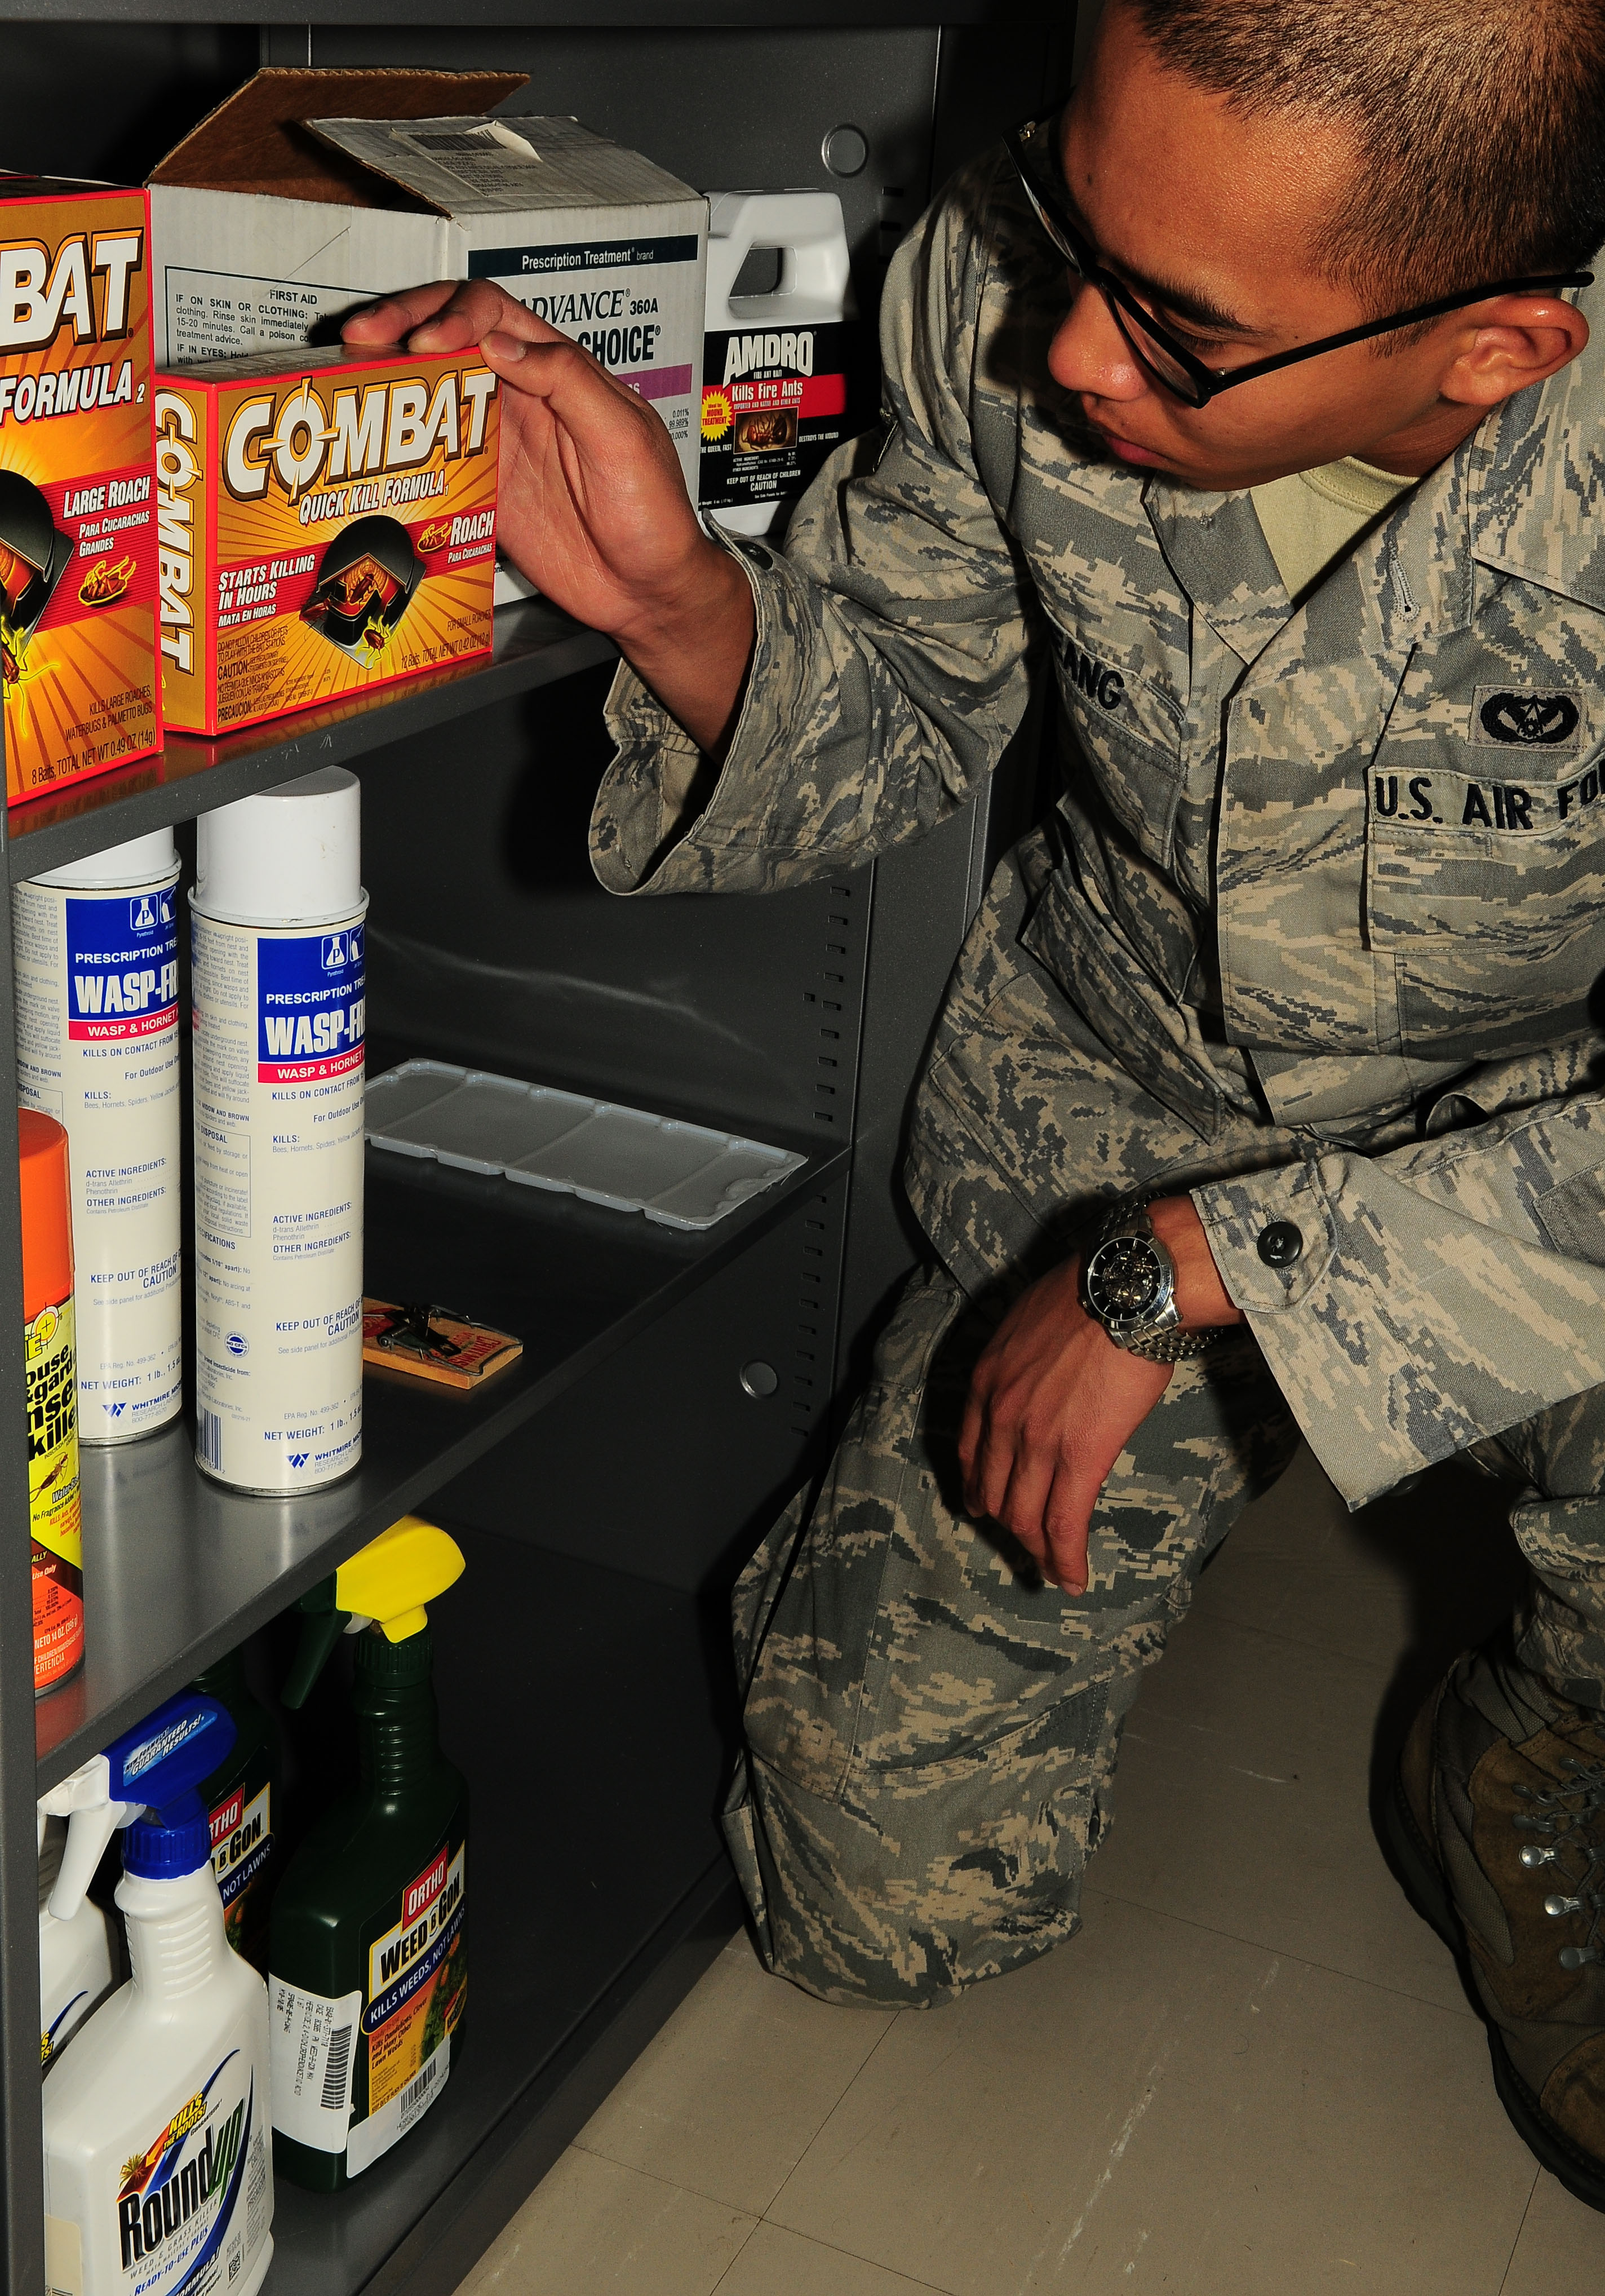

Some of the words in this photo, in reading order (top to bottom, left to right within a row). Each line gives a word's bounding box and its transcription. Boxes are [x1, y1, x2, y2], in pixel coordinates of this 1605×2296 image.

[522, 252, 581, 271] Prescription
[584, 247, 631, 265] Treatment
[637, 249, 654, 261] brand
[176, 294, 184, 303] IF
[190, 296, 203, 306] ON
[210, 298, 231, 309] SKIN
[238, 302, 251, 312] OR
[258, 305, 308, 320] CLOTHING:
[269, 289, 298, 302] FIRST
[300, 294, 317, 305] AID
[629, 298, 659, 316] 360A
[176, 306, 208, 319] clothing.
[213, 311, 236, 321] Rinse
[240, 315, 256, 324] skin
[261, 317, 309, 333] immediately
[176, 317, 198, 328] 15-20
[202, 322, 235, 333] minutes.
[240, 326, 255, 335] Call
[269, 329, 295, 341] poison
[176, 329, 213, 341] treatment
[215, 334, 243, 345] advice.
[177, 343, 184, 352] IF
[201, 347, 227, 358] EYES:
[722, 331, 814, 389] AMDRO
[0, 361, 133, 425] FORMULA
[731, 385, 754, 402] Kills
[758, 382, 777, 399] Fire
[782, 379, 803, 397] Ants
[227, 369, 497, 502] COMBAT
[750, 480, 777, 492] CAUTION
[757, 474, 772, 483] REACH
[773, 472, 779, 481] OF
[779, 470, 801, 479] CHILDREN
[64, 485, 105, 519] LARGE
[110, 475, 151, 506] ROACH
[299, 490, 346, 525] QUICK
[349, 483, 380, 514] KILL
[384, 470, 444, 506] FORMULA
[79, 521, 100, 540] PARA
[102, 510, 150, 533] CUCARACHAS
[156, 393, 202, 676] COMBAT
[449, 510, 495, 547] ROACH
[79, 537, 114, 558] GRANDES
[447, 551, 462, 564] PARA
[462, 542, 493, 560] CUCARACHAS
[218, 567, 266, 594] STARTS
[269, 554, 316, 583] KILLING
[218, 589, 234, 611] IN
[236, 582, 277, 608] HOURS
[218, 612, 241, 627] MATA
[241, 611, 252, 622] EN
[252, 604, 277, 620] HORAS
[218, 660, 250, 681] CAUTION:
[1053, 629, 1125, 710] ANG
[90, 701, 105, 716] KILLS
[105, 694, 125, 711] LARGE
[125, 684, 152, 705] ROACHES,
[218, 697, 253, 722] PRECAUCIÓN:
[65, 718, 101, 742] WATERBUGS
[102, 716, 107, 729] &
[108, 705, 136, 727] PALMETTO
[138, 701, 153, 716] BUGS
[32, 768, 37, 785] 8
[38, 763, 57, 784] Baits,
[57, 753, 81, 775] TOTAL
[82, 747, 96, 767] NET
[97, 742, 109, 761] WT
[110, 737, 126, 757] 0.49
[127, 733, 137, 751] OZ
[138, 727, 156, 751] (14g)
[1375, 776, 1443, 824] U.S.
[1463, 783, 1534, 830] AIR
[75, 943, 163, 964] PRESCRIPTION
[74, 958, 179, 1014] WASP-FR
[266, 984, 353, 1006] PRESCRIPTION
[87, 1021, 127, 1037] WASP
[130, 1023, 138, 1033] &
[141, 1010, 176, 1032] HORNET
[83, 1048, 107, 1058] KILLS
[110, 1047, 122, 1057] ON
[125, 1042, 158, 1055] CONTACT
[159, 1035, 174, 1046] FROM
[277, 1065, 316, 1080] WASP
[319, 1065, 327, 1076] &
[330, 1053, 362, 1074] HORNET
[272, 1091, 296, 1101] KILLS
[299, 1090, 312, 1099] ON
[314, 1083, 345, 1098] CONTACT
[347, 1077, 360, 1090] FROM
[313, 1114, 326, 1123] For
[327, 1107, 352, 1121] Outdoor
[273, 1135, 300, 1144] KILLS:
[273, 1213, 303, 1224] ACTIVE
[305, 1202, 352, 1222] INGREDIENTS:
[273, 1242, 300, 1253] OTHER
[304, 1231, 351, 1251] INGREDIENTS:
[90, 1273, 114, 1284] KEEP
[116, 1272, 135, 1284] OUT
[138, 1269, 149, 1280] OF
[150, 1259, 171, 1276] REACH
[143, 1265, 177, 1289] CAUTION
[276, 1321, 300, 1331] KEEP
[303, 1318, 320, 1330] OUT
[323, 1315, 334, 1326] OF
[335, 1304, 354, 1322] REACH
[328, 1311, 359, 1336] CAUTION
[81, 1381, 99, 1391] NET
[101, 1375, 141, 1390] WEIGHT:
[132, 1391, 170, 1410] WHITMIRE
[264, 1431, 282, 1441] NET
[286, 1426, 325, 1440] WEIGHT:
[314, 1440, 352, 1461] WHITMIRE
[132, 1720, 187, 1776] GUARANTEED
[162, 1713, 202, 1757] RESULTS!
[229, 1811, 261, 1864] GON
[223, 1872, 241, 1900] NOT
[242, 1843, 271, 1882] LAWNS
[408, 1861, 444, 1917] ORTHO
[380, 1919, 428, 1984] WEED
[438, 1871, 460, 1927] GON
[371, 1991, 397, 2024] KILLS
[399, 1959, 432, 1998] WEEDS,
[433, 1939, 447, 1963] NOT
[447, 1903, 465, 1941] LAWNS
[163, 2135, 175, 2151] THE
[175, 2103, 207, 2140] ROOTS!
[169, 2092, 203, 2137] KILLS
[130, 2259, 154, 2280] WEED
[167, 2226, 192, 2251] GRASS
[195, 2198, 218, 2225] KILLER
[134, 2245, 190, 2296] READY-TO-USE
[190, 2227, 209, 2251] PLUS
